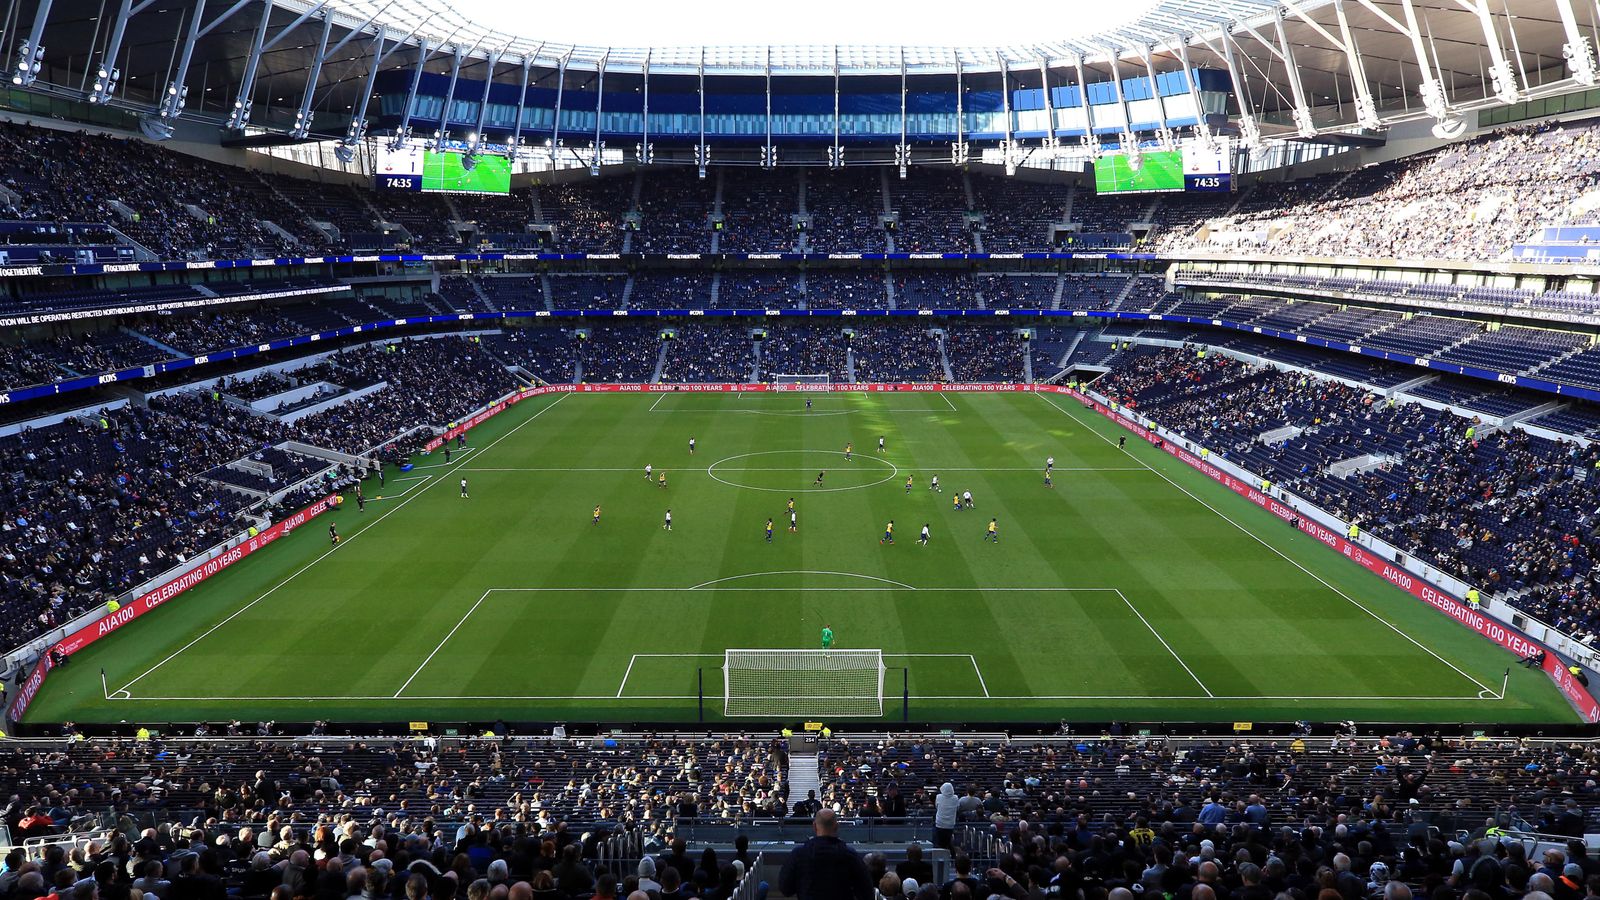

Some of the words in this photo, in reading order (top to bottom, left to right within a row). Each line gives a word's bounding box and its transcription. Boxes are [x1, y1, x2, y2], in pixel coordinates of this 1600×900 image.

[386, 178, 411, 188] 74:35
[1194, 177, 1219, 188] 74:35
[17, 317, 31, 325] WILL
[40, 312, 71, 322] OPERATING
[71, 310, 102, 319] RESTRICTED
[103, 307, 134, 315] NORTHBOUND
[158, 302, 183, 310] SUPPORTERS
[184, 299, 205, 307] TRAVELLING
[1475, 305, 1506, 315] NORTHBOUND
[1533, 311, 1568, 321] SUPPORTERS
[195, 356, 208, 364] #COYS
[1415, 357, 1429, 367] #COYS
[99, 373, 117, 383] #COYS
[1498, 372, 1517, 385] #COYS
[1164, 442, 1175, 454] AIA100
[1178, 450, 1201, 469] CELEBRATING
[1207, 465, 1221, 480] YEARS
[284, 512, 305, 530] AIA100
[1248, 489, 1266, 506] AIA100
[1305, 521, 1316, 535] 100
[1317, 527, 1336, 546] YEARS
[98, 606, 134, 635] AIA100
[145, 569, 203, 608] CELEBRATING
[203, 557, 218, 576] 100
[219, 547, 242, 571] YEARS
[1383, 565, 1412, 590] AIA100
[1421, 587, 1483, 630] CELEBRATING
[1486, 622, 1504, 642] 100
[17, 693, 26, 715] 100
[25, 669, 42, 701] YEARS
[1137, 834, 1150, 845] 18
